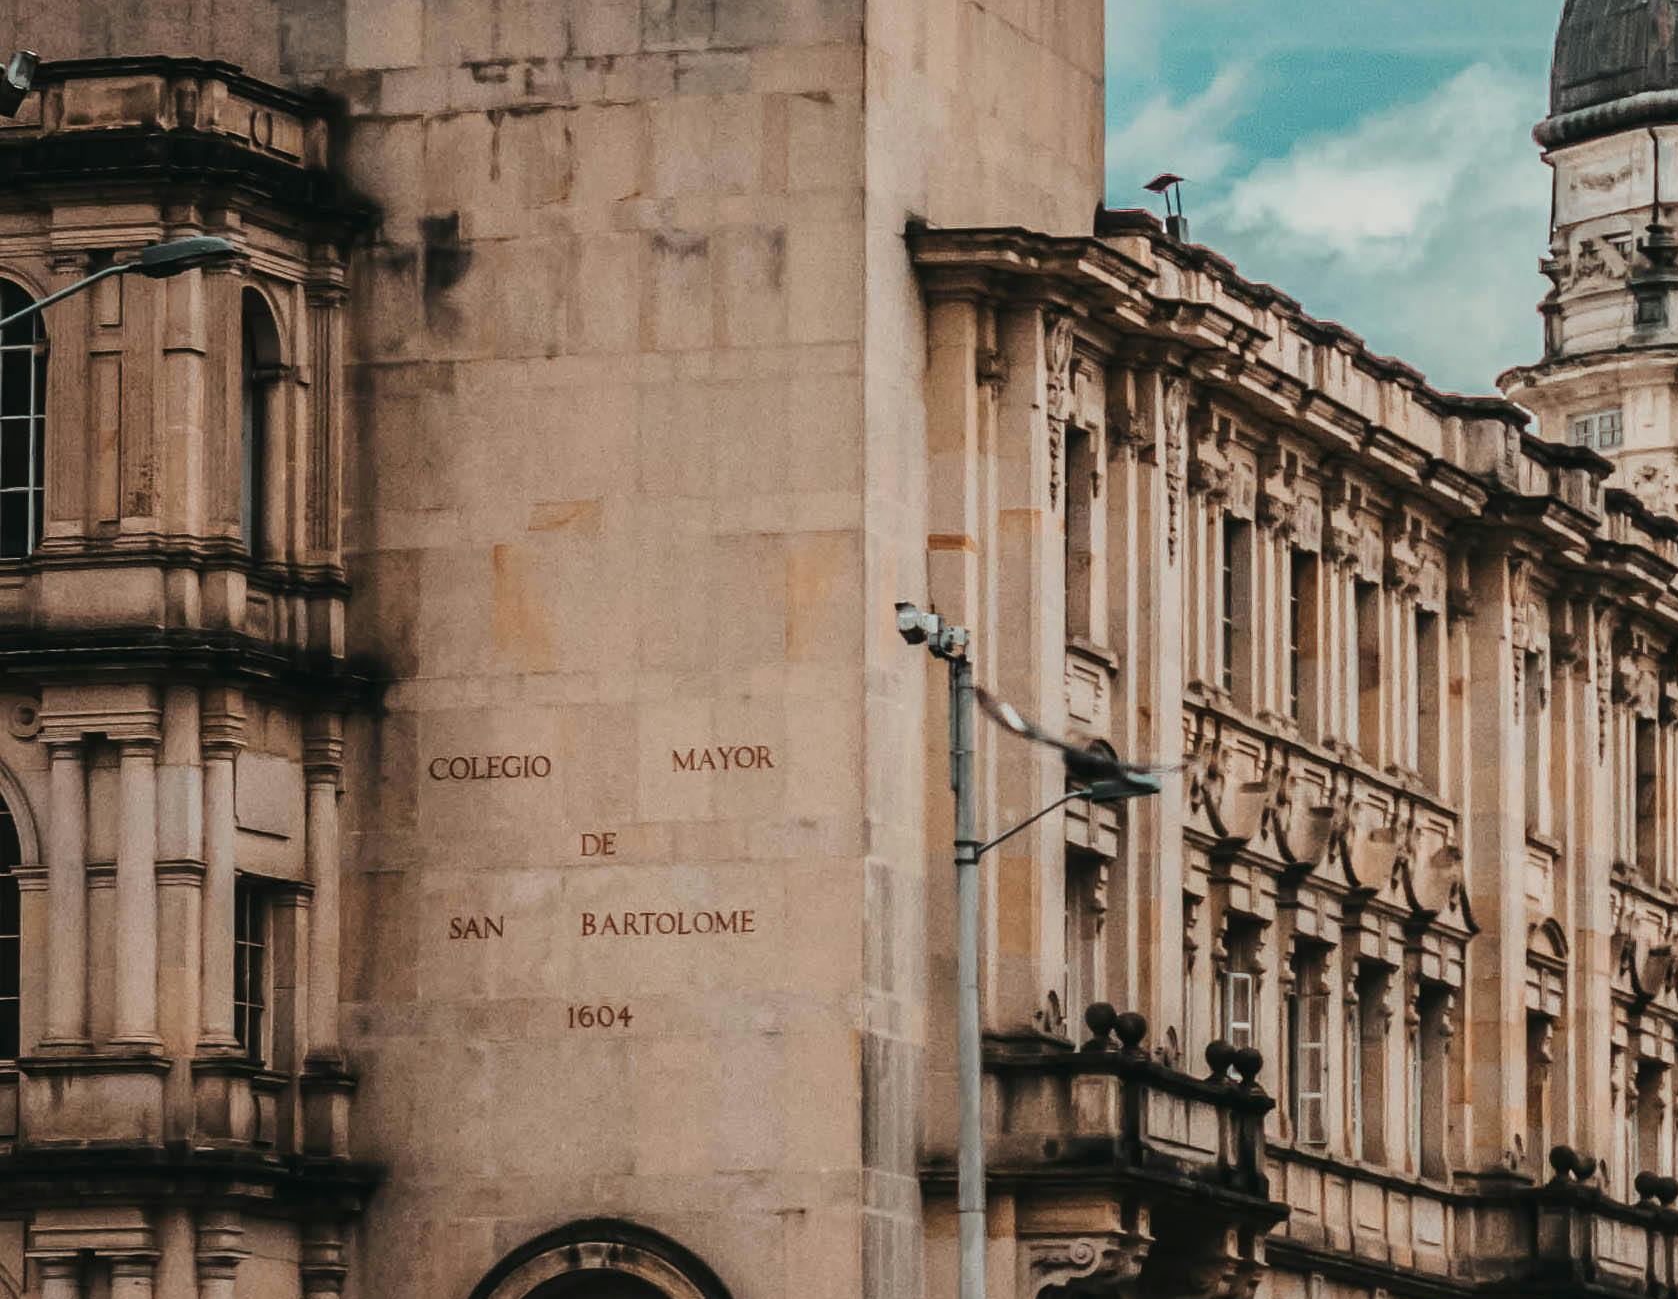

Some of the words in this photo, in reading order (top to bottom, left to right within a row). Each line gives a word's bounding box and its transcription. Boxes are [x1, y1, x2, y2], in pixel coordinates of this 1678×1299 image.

[428, 755, 552, 781] COLEGIO
[672, 745, 775, 772] MAYOR
[581, 832, 618, 856] DE
[448, 915, 504, 940] SAN
[581, 910, 756, 936] BARTOLOME
[567, 1005, 634, 1029] 1604
